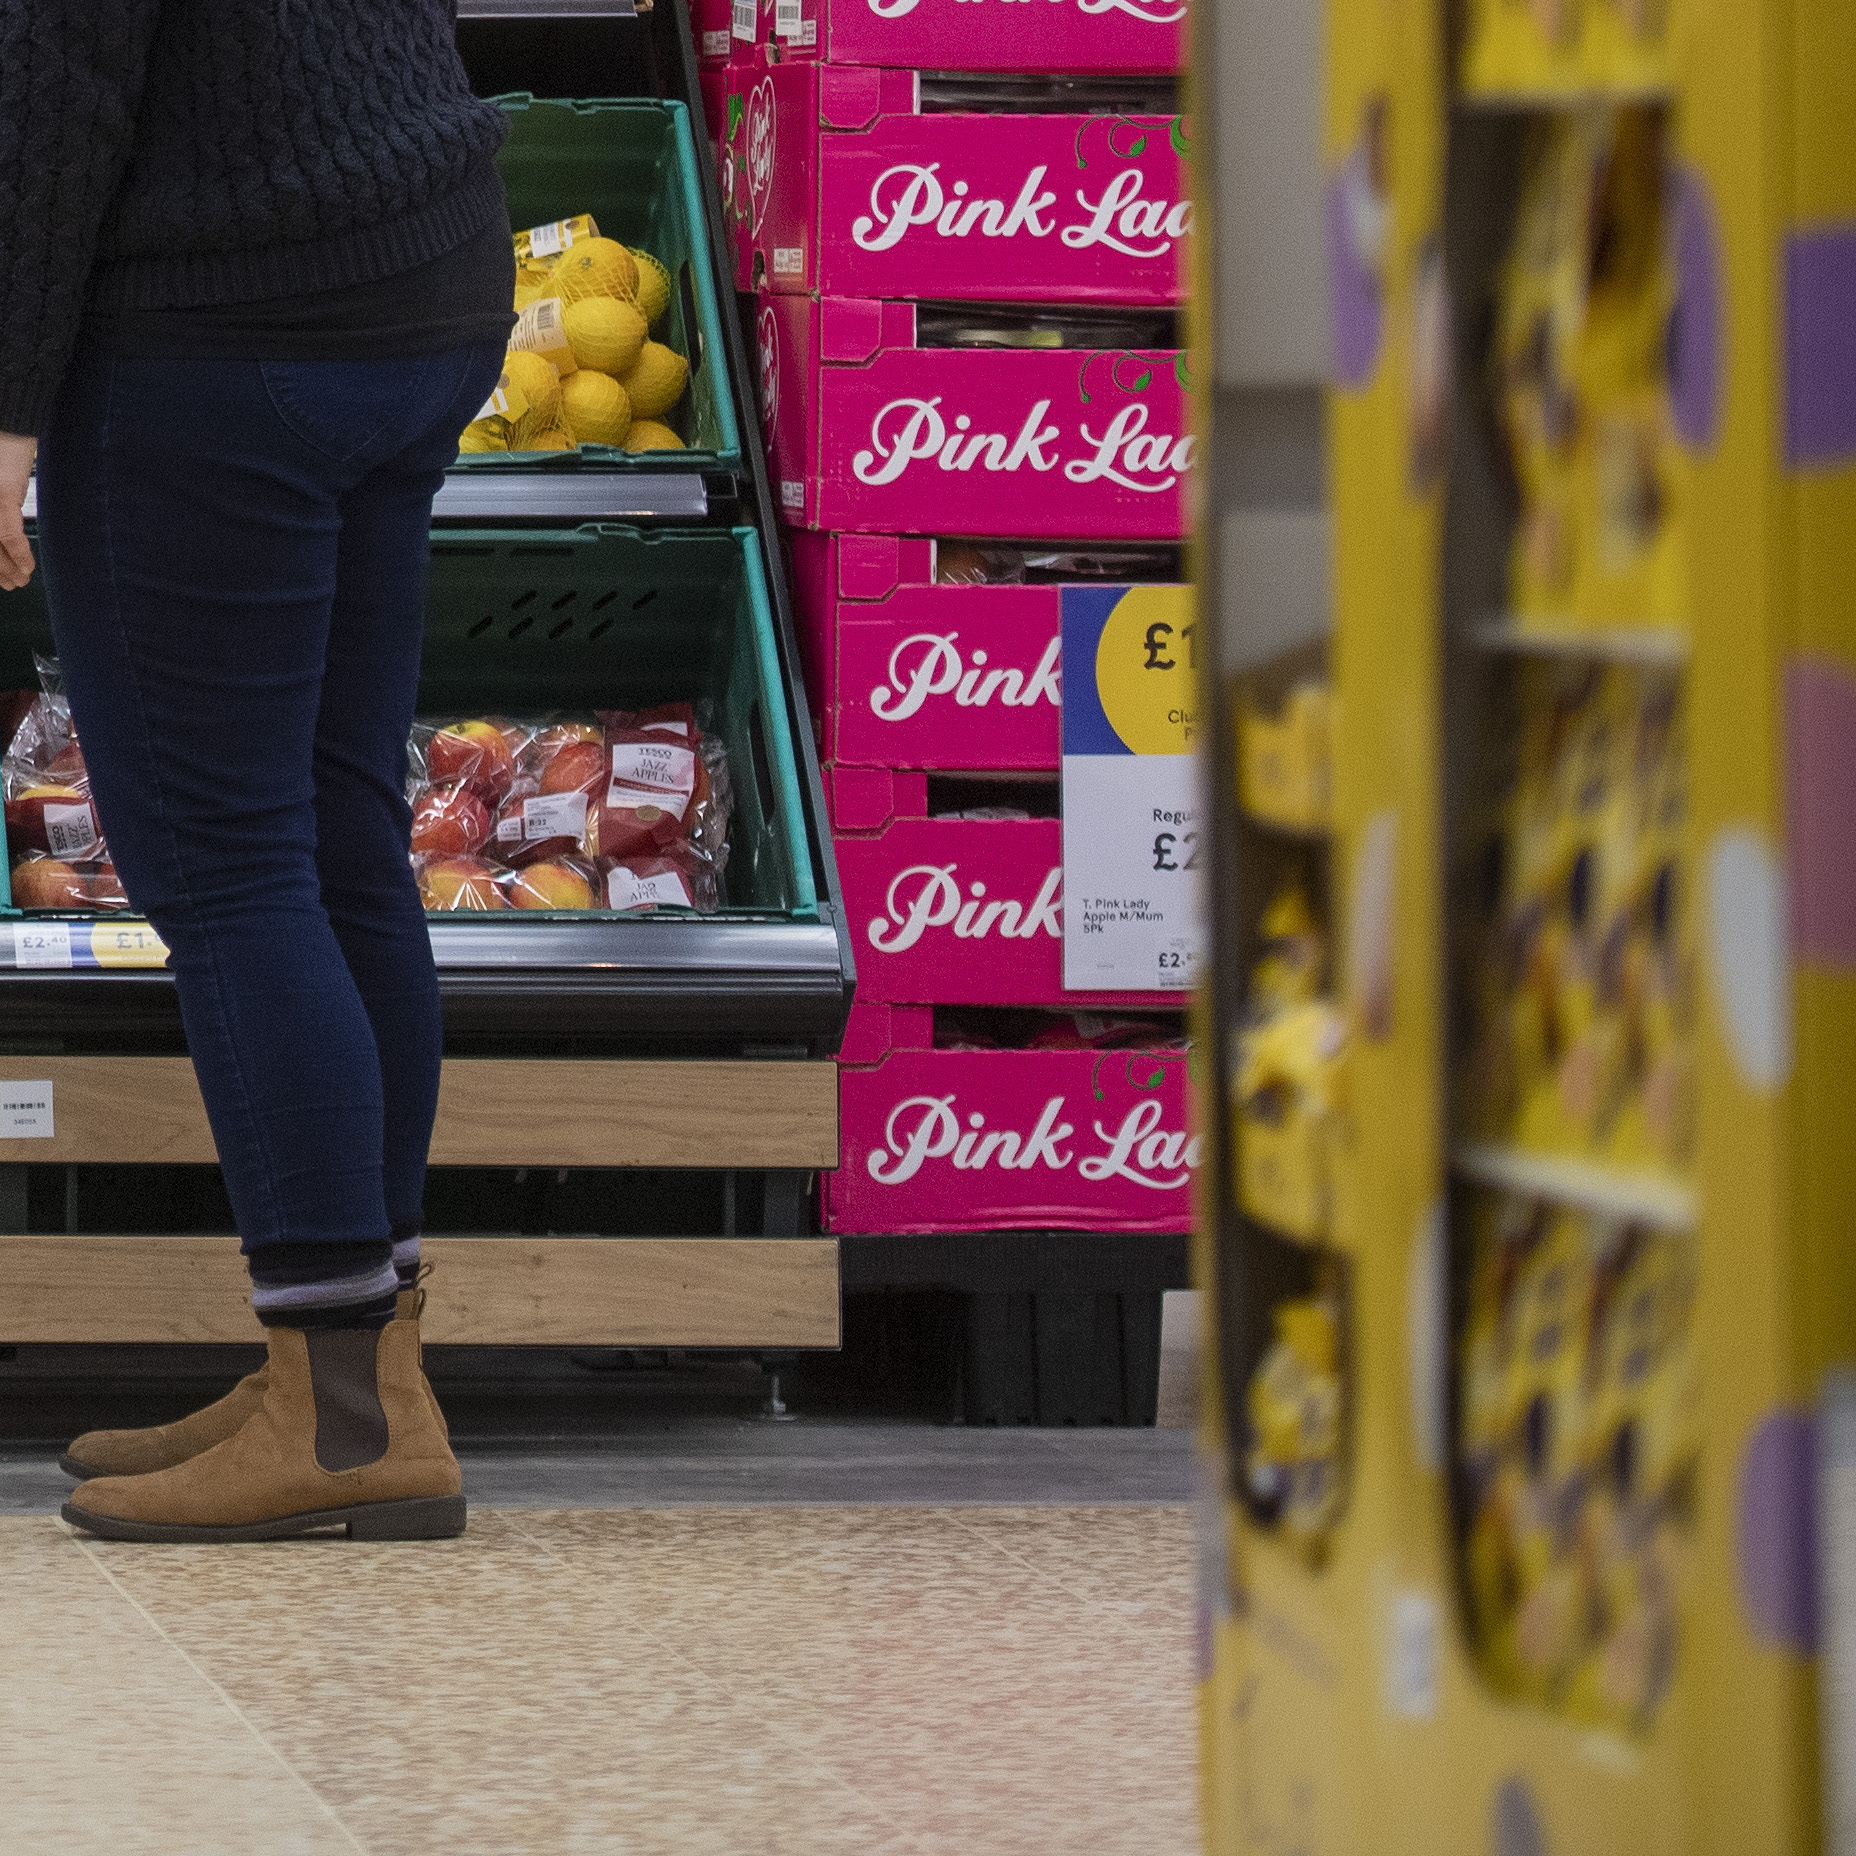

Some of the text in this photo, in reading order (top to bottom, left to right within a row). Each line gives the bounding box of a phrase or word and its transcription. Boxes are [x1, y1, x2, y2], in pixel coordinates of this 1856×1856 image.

[851, 162, 1057, 252] Pink
[852, 396, 1061, 486] Pink
[869, 630, 1062, 722] Pink
[638, 747, 673, 758] TESCO
[640, 758, 670, 773] JAZZ
[631, 767, 675, 785] APPLES
[867, 862, 1063, 953] Pink
[1095, 898, 1120, 909] Pink
[1123, 898, 1151, 911] Lady
[1083, 911, 1164, 923] Apple M/Mum
[23, 936, 67, 949] £2.40
[867, 1093, 1074, 1185] Pink
